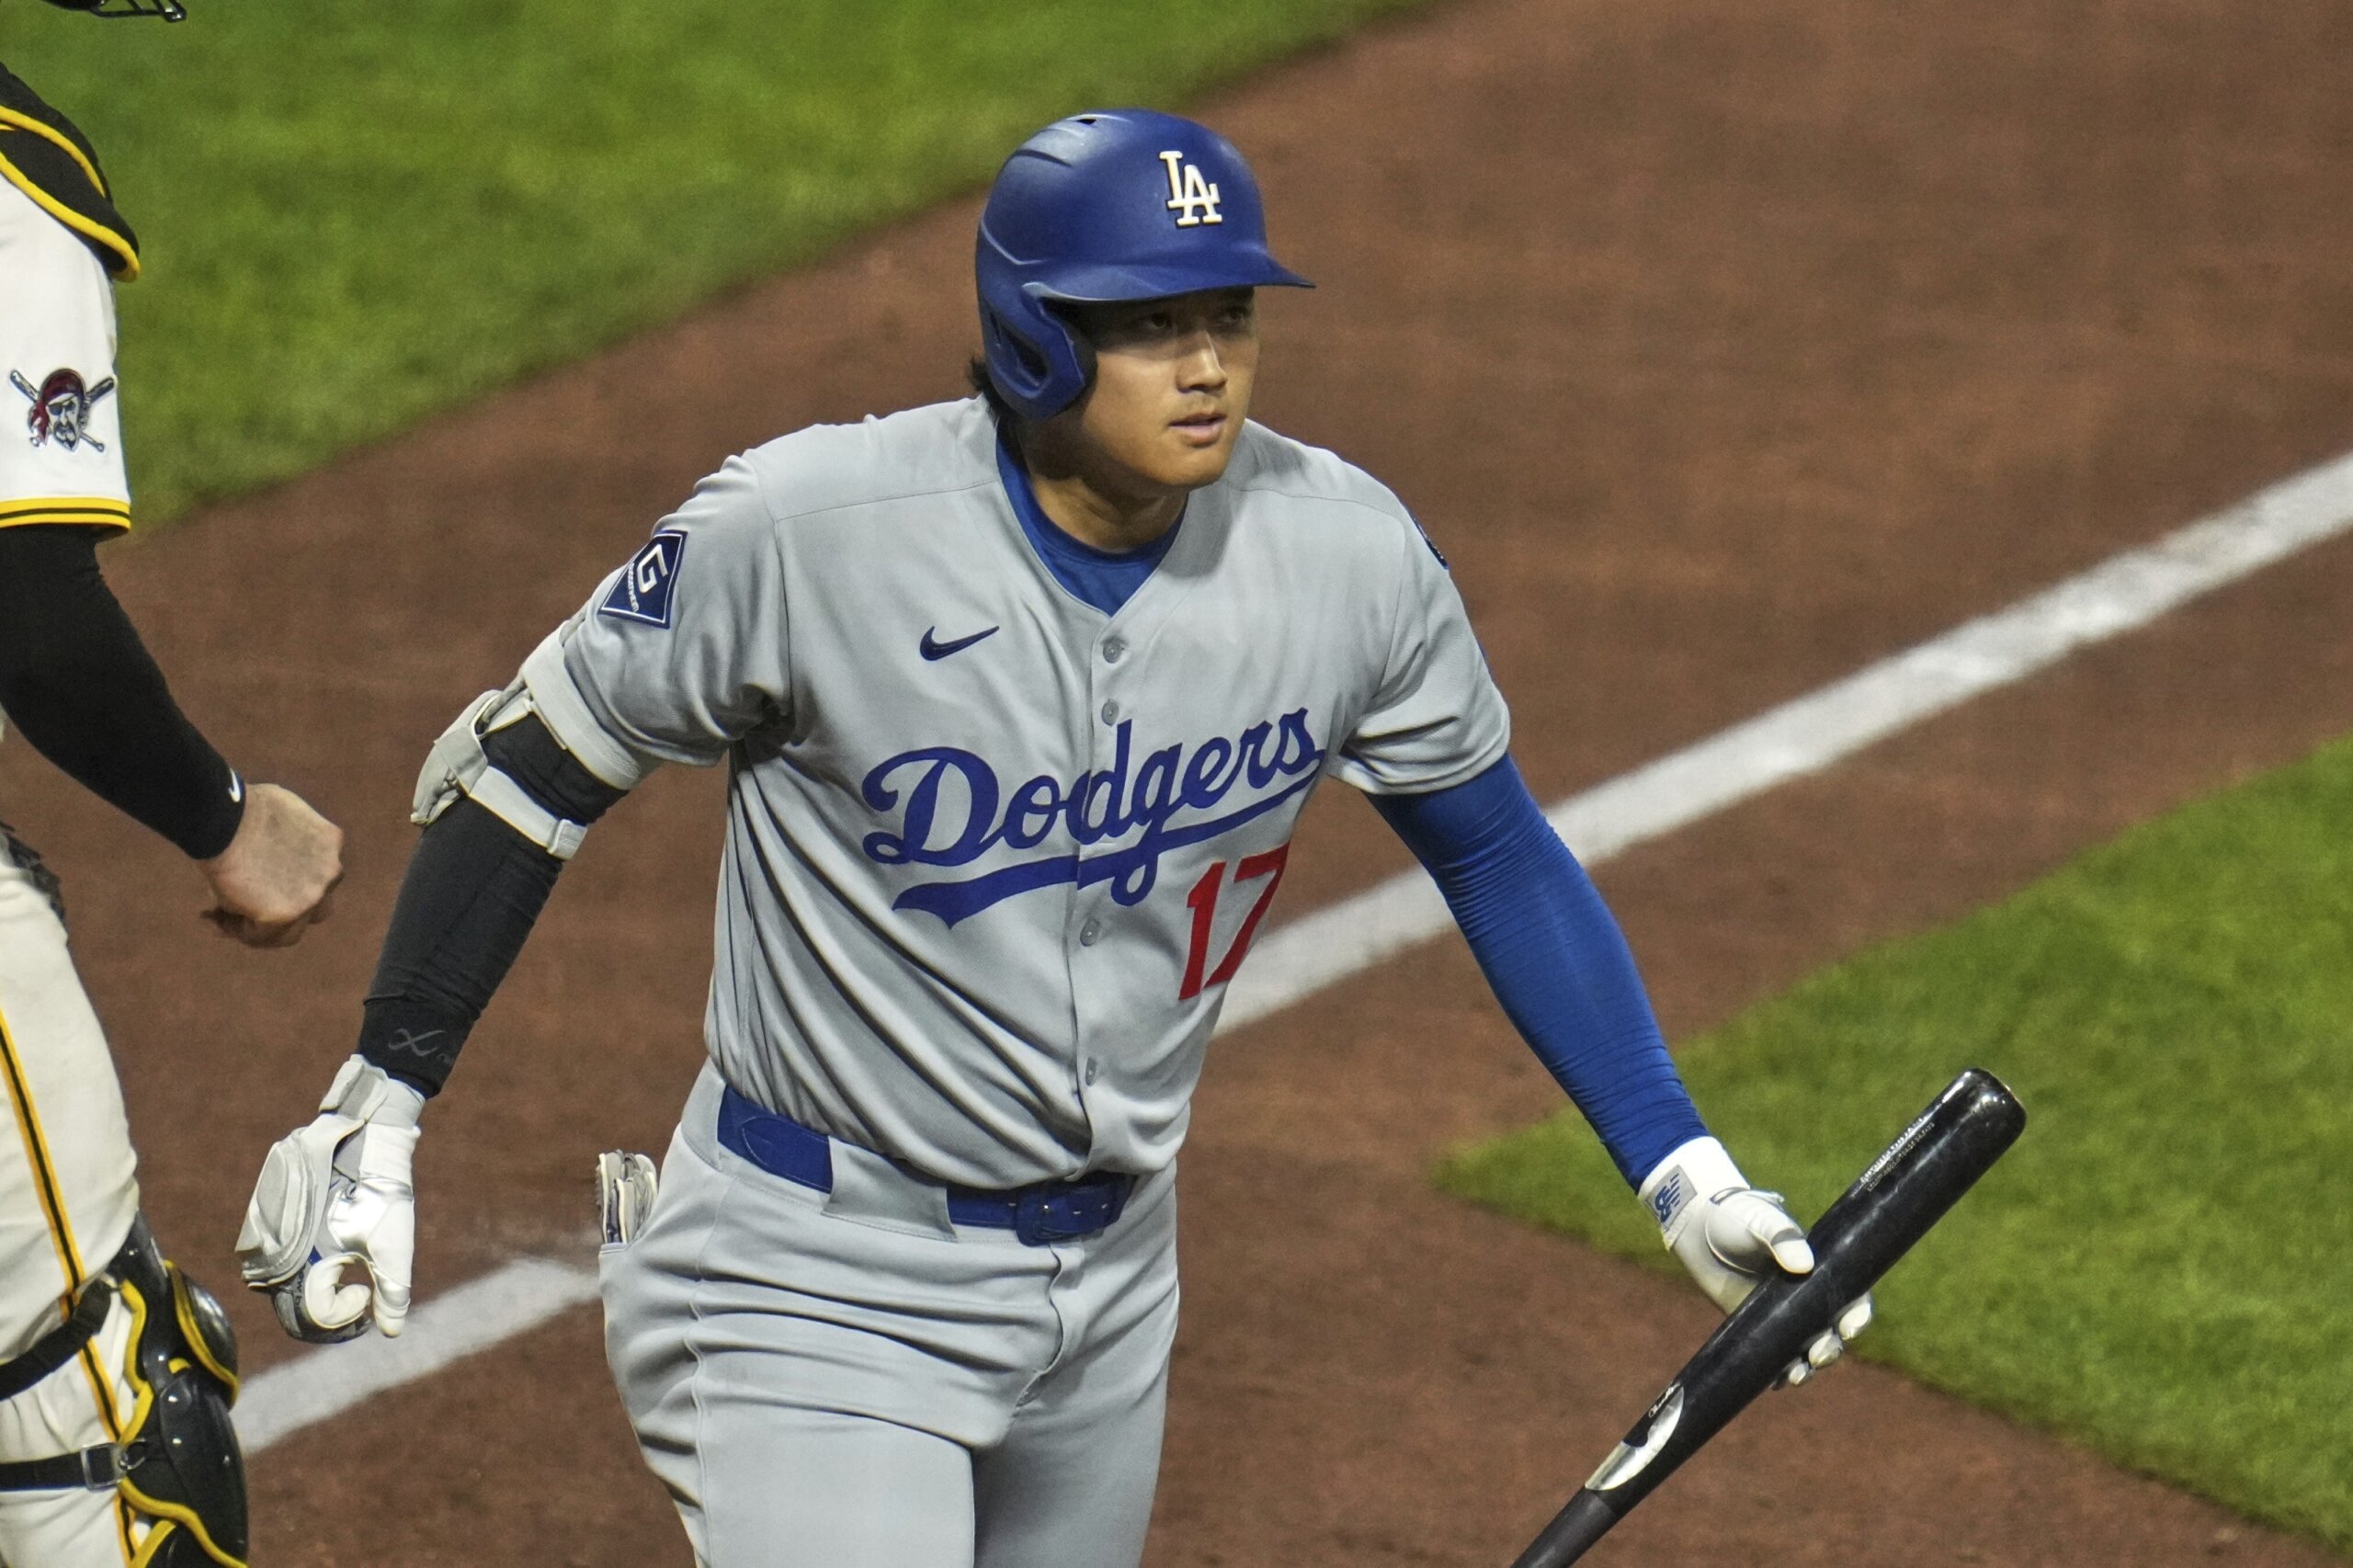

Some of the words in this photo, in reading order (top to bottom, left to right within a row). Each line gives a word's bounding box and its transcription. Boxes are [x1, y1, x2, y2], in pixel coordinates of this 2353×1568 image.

[1158, 150, 1222, 227] LA
[861, 707, 1325, 907] Dodgers
[1177, 841, 1290, 1002] 17
